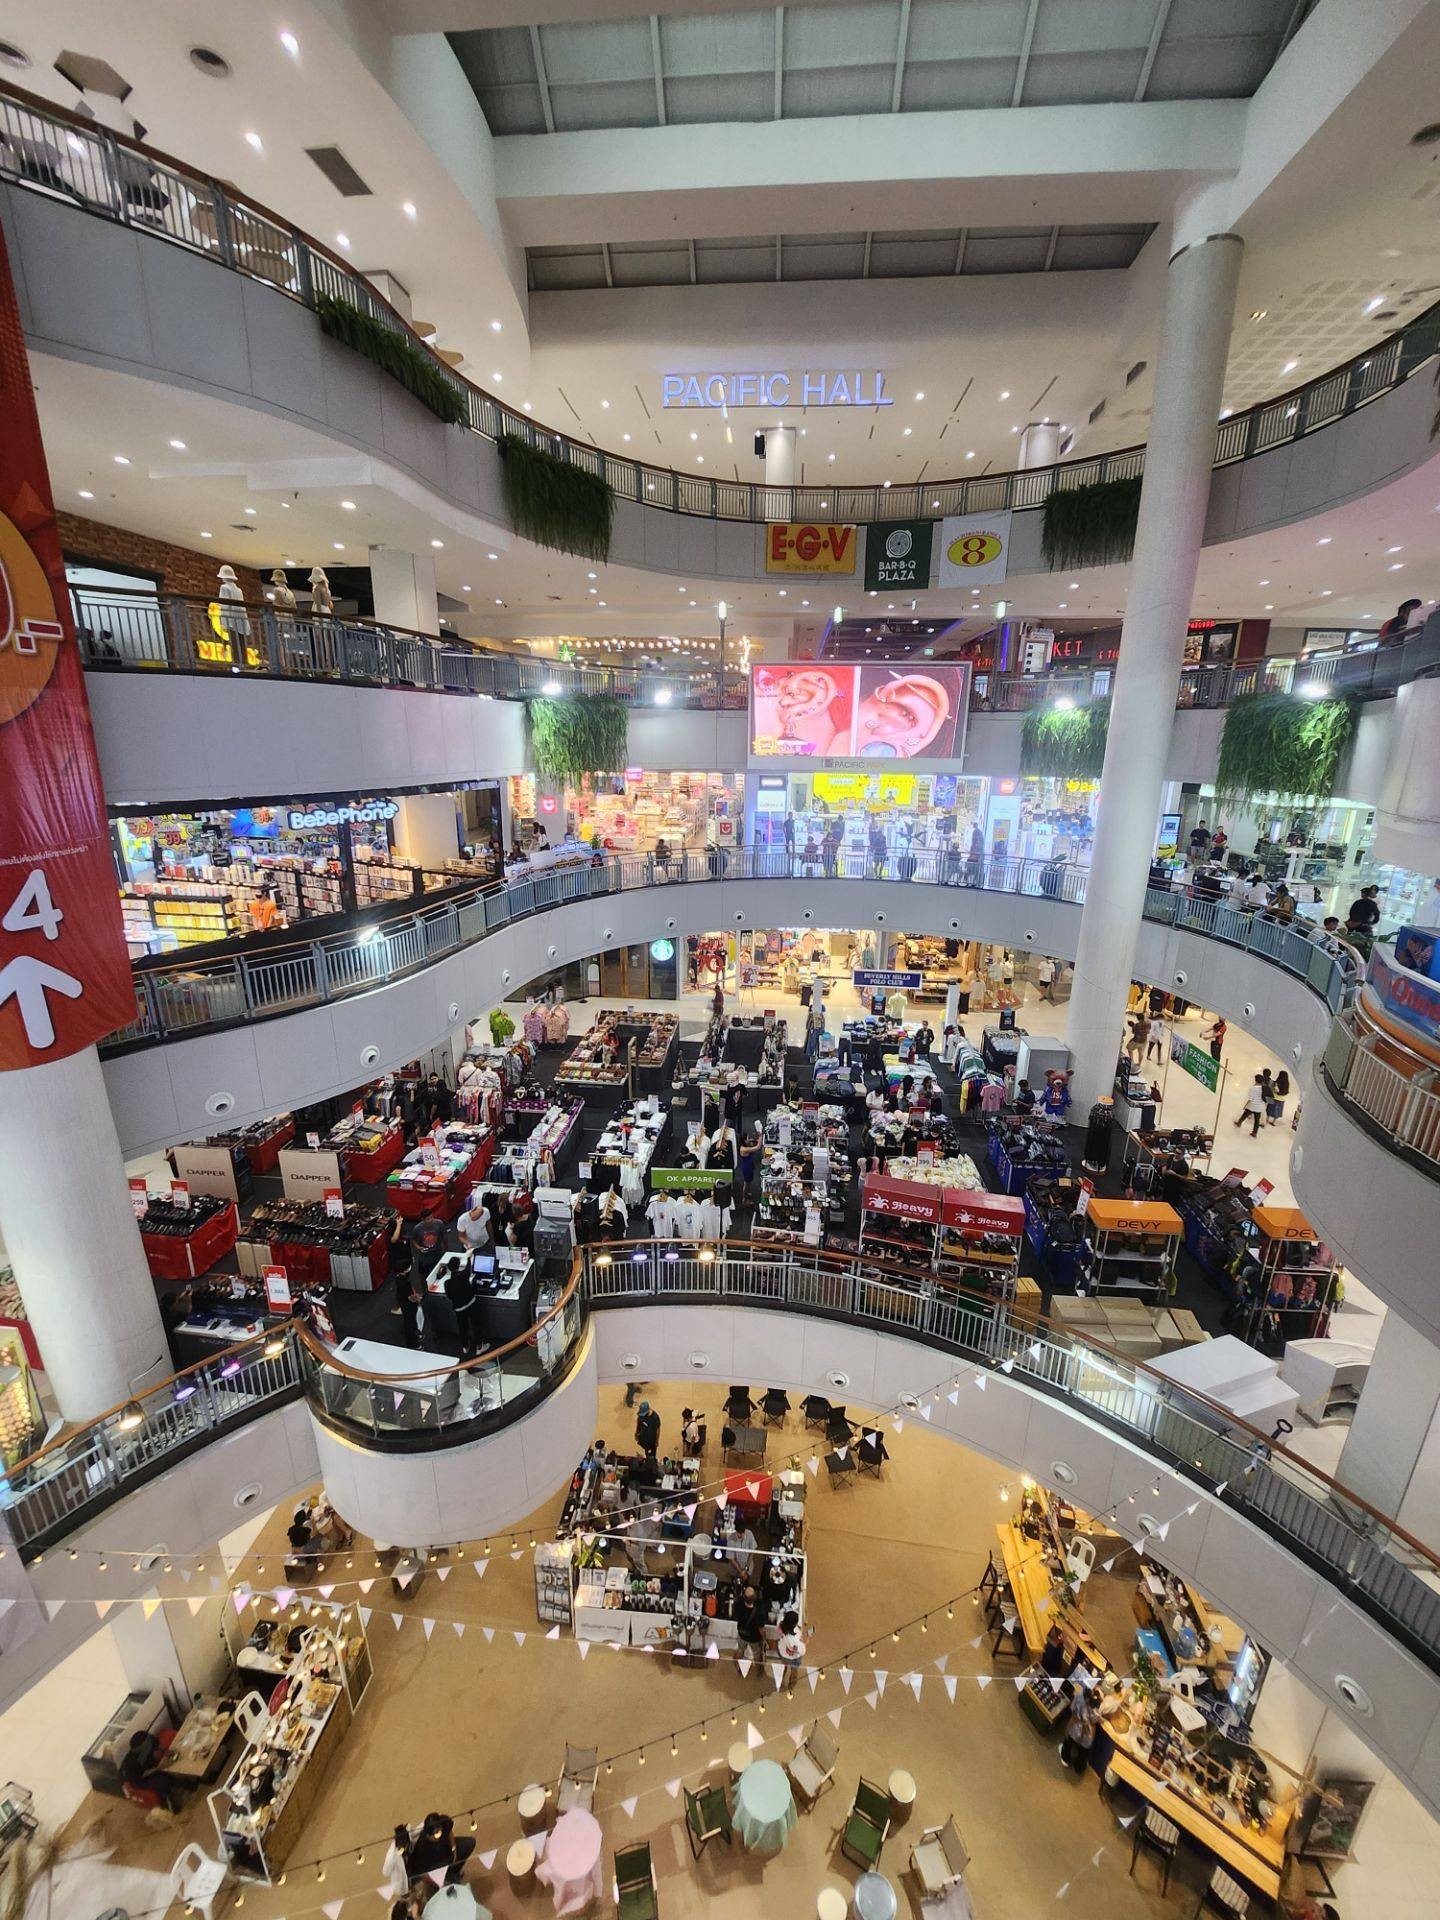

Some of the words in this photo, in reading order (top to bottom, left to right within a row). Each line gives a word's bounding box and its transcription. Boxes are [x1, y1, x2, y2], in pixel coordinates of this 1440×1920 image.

[662, 373, 791, 407] PACIFIC
[802, 372, 894, 405] HALL
[878, 570, 916, 581] PLAZA
[290, 806, 395, 830] BeBePhone
[2, 868, 64, 941] 4
[1188, 1048, 1217, 1073] FASHION
[186, 1168, 226, 1177] DAPPER
[290, 1173, 332, 1182] DAPPER
[891, 1201, 934, 1217] Heavy
[977, 1217, 1010, 1229] Heavy
[1117, 1220, 1162, 1230] DEVY
